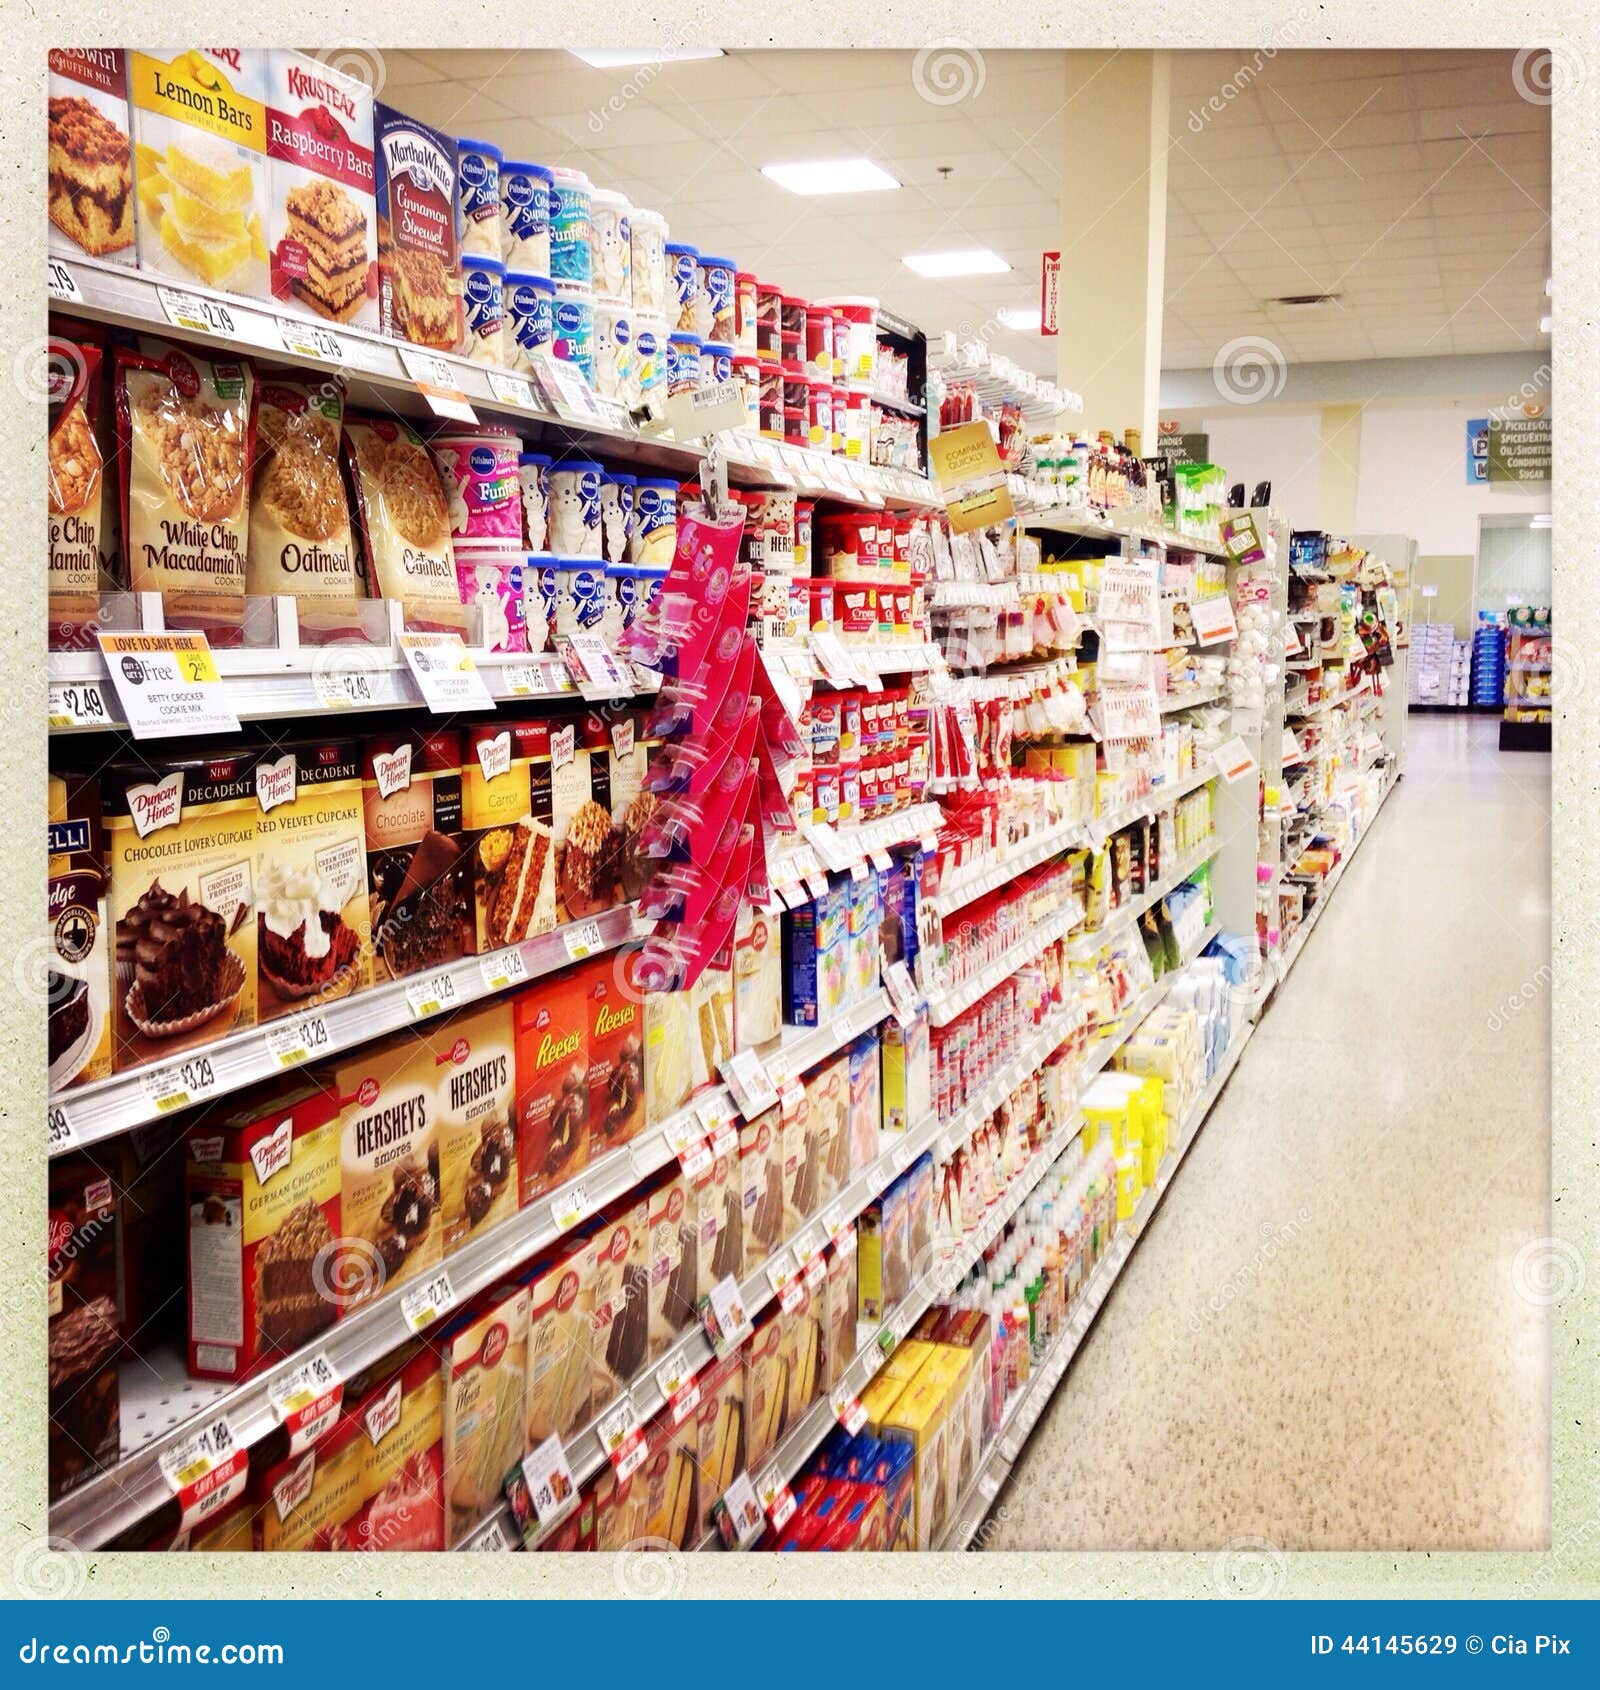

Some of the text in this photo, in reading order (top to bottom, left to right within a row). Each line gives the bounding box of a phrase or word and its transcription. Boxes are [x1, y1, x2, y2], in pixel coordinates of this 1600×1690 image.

[95, 71, 112, 87] MIX
[154, 72, 252, 131] Lemon Bars
[288, 66, 356, 121] KRUSTEAZ
[271, 120, 344, 170] Raspberry
[347, 152, 374, 179] Bars
[462, 163, 486, 175] Pillsbury
[508, 182, 532, 195] Pillsbury
[397, 183, 448, 226] Cinnamon
[402, 212, 444, 244] Streusel
[48, 264, 75, 292] .79
[469, 280, 491, 292] Pillsbury
[515, 293, 537, 305] Pillsbury
[200, 303, 235, 333] $2.79
[559, 312, 581, 325] Pillsbury
[946, 441, 987, 461] COMPARE
[949, 453, 984, 470] QUICKLY
[470, 456, 495, 468] Pillsbury
[1519, 469, 1544, 479] SUGAR
[64, 516, 94, 546] Chip
[161, 520, 239, 555] White Chip
[143, 544, 233, 574] Macadamia
[280, 543, 350, 573] Oatmeal
[115, 637, 136, 651] LOVE
[138, 638, 151, 650] TO
[153, 637, 174, 650] SAVE
[141, 660, 174, 681] Free
[147, 692, 205, 704] BETTY CROCKER
[344, 676, 371, 700] $2.49
[63, 688, 104, 718] $2.49
[160, 705, 203, 715] COOKIE MIX
[319, 751, 338, 761] NEW!
[484, 742, 508, 760] Duncan
[210, 767, 231, 778] NEW!
[301, 764, 356, 782] DECADENT
[380, 756, 408, 777] Duncan
[489, 757, 506, 773] Hines
[260, 765, 292, 788] Duncan
[385, 771, 406, 787] Hines
[133, 785, 177, 812] Duncan
[189, 782, 251, 801] DECADENT
[266, 781, 291, 801] Hines
[488, 793, 518, 808] Carrot
[143, 805, 175, 827] Hines
[257, 808, 358, 834] RED VELVET CUPCAKE
[376, 812, 426, 830] Chocolate
[124, 829, 252, 862] CHOCOLATE LOVER'S CUPCAKE
[208, 872, 243, 892] CHOCOLATE
[209, 882, 243, 899] FROSTING
[432, 975, 455, 1001] $3.29
[299, 1019, 328, 1048] $3.29
[181, 1058, 215, 1090] $3.29
[450, 1055, 507, 1111] HERSHEY'S
[466, 1097, 496, 1121] smores
[356, 1094, 426, 1159] HERSHEY'S
[256, 1130, 288, 1163] Duncan
[374, 1141, 412, 1168] smores
[249, 1184, 290, 1211] GERMAN
[291, 1156, 338, 1190] CHOCOLATE
